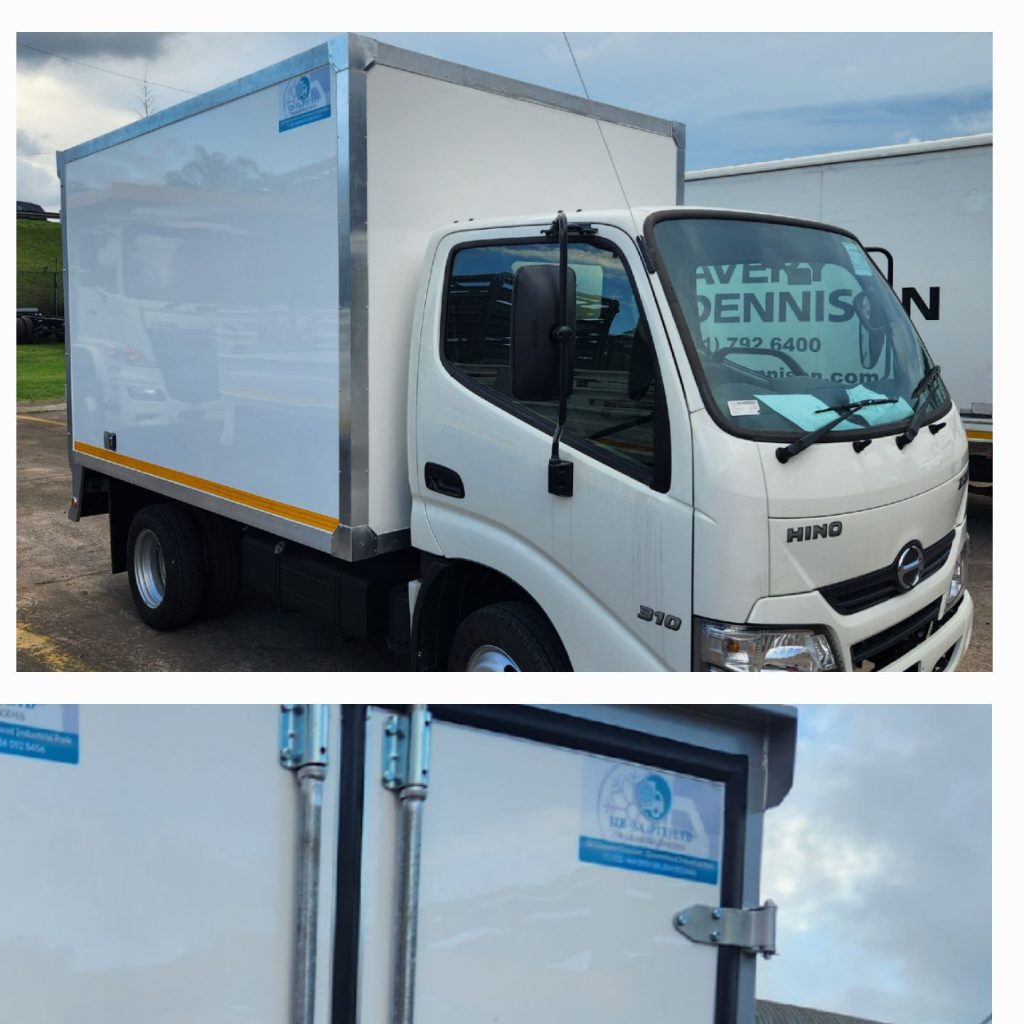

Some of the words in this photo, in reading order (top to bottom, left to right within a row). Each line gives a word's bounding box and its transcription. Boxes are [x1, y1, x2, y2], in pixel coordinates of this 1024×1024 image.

[770, 336, 822, 353] 6400
[786, 521, 843, 544] HINO
[637, 605, 682, 631] 310
